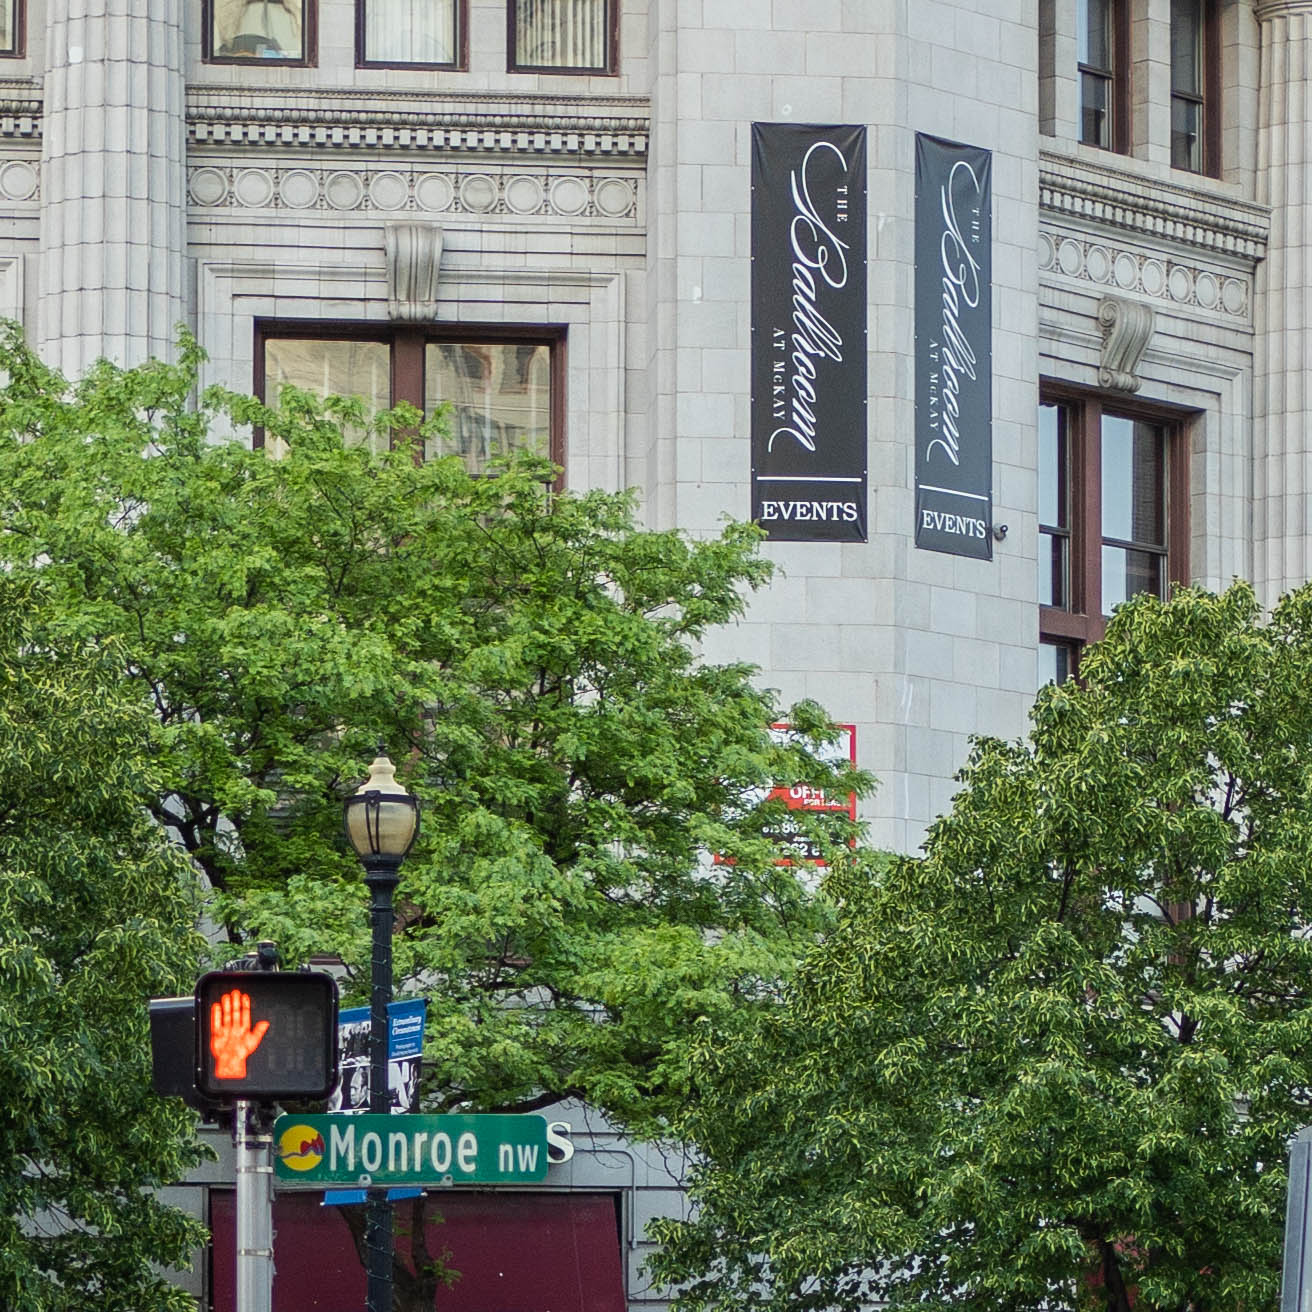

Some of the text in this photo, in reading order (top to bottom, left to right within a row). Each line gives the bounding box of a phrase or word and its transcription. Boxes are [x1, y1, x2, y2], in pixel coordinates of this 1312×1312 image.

[836, 185, 848, 222] THE
[971, 207, 980, 243] THE
[768, 141, 850, 452] Ballroom
[927, 161, 981, 465] Ballroom
[773, 327, 786, 350] AT
[761, 501, 857, 522] EVENTS
[922, 509, 986, 538] EVENTS
[329, 1124, 478, 1173] Monroe
